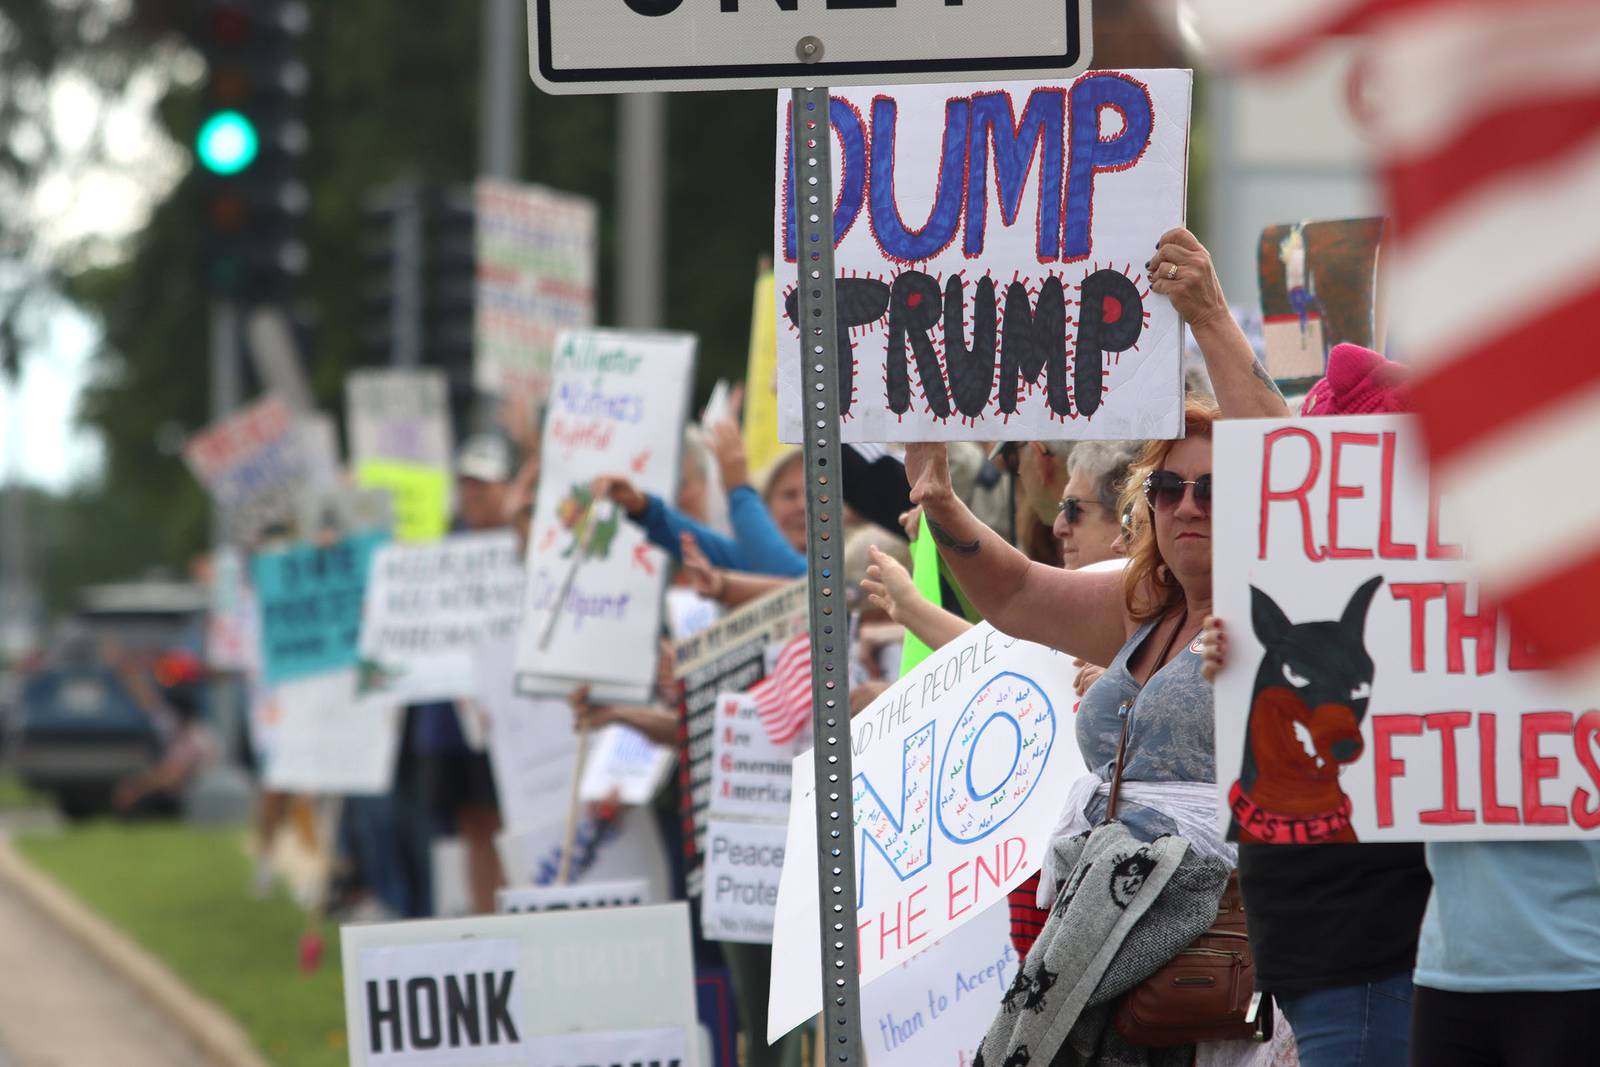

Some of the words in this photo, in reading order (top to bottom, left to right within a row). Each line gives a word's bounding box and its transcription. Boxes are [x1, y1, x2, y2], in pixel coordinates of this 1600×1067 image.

[783, 70, 1154, 265] DUMP
[783, 265, 1147, 421] TRUMP
[876, 682, 917, 741] THE
[920, 630, 997, 709] PEOPLE
[851, 671, 1057, 911] NO
[1371, 709, 1600, 830] FILES
[712, 836, 785, 868] Peace
[715, 875, 778, 906] Prote
[857, 884, 930, 977] THE
[948, 836, 1029, 921] END.
[366, 970, 521, 1054] HONK
[878, 1012, 925, 1053] than
[928, 988, 949, 1020] to
[955, 943, 1014, 1002] Accept
